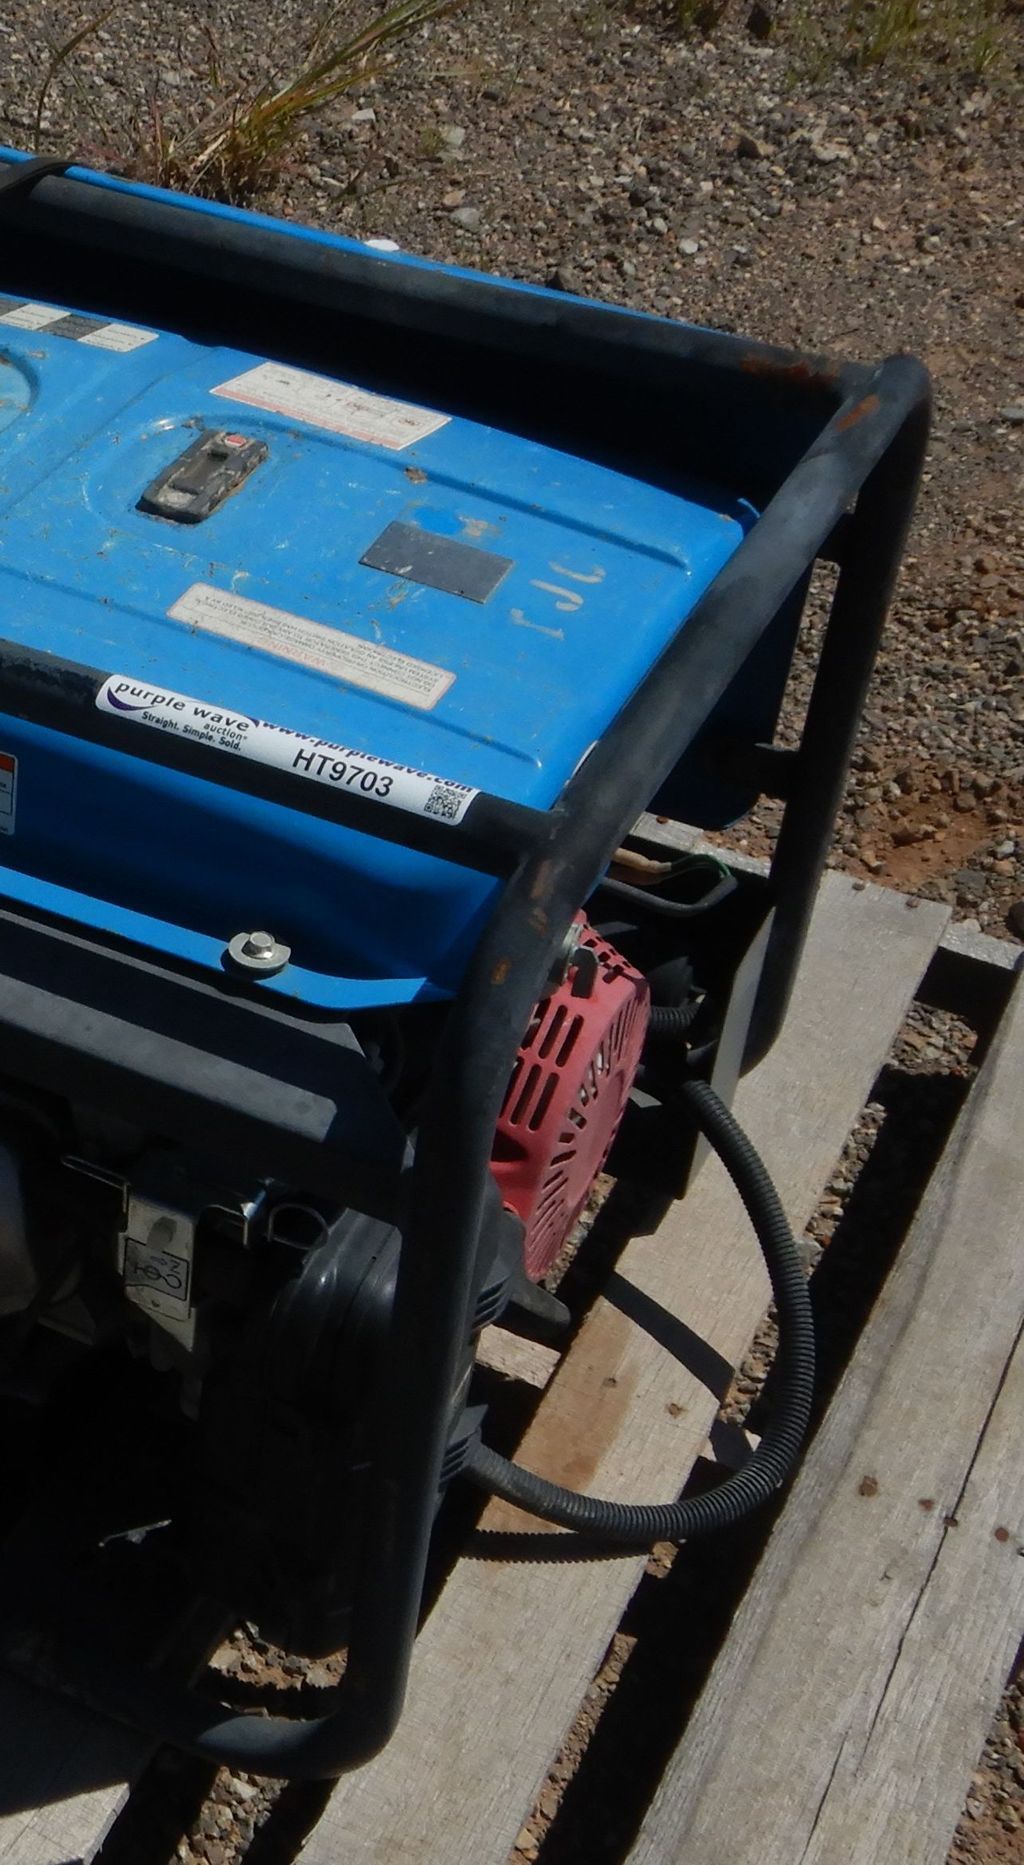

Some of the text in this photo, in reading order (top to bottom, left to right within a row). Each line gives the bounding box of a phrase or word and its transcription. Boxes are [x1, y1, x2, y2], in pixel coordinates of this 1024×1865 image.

[115, 682, 249, 731] purple wave
[142, 711, 241, 751] Straight. Simple. Sold.
[263, 722, 472, 793] www.purplewave.com
[292, 748, 394, 797] HT9703
